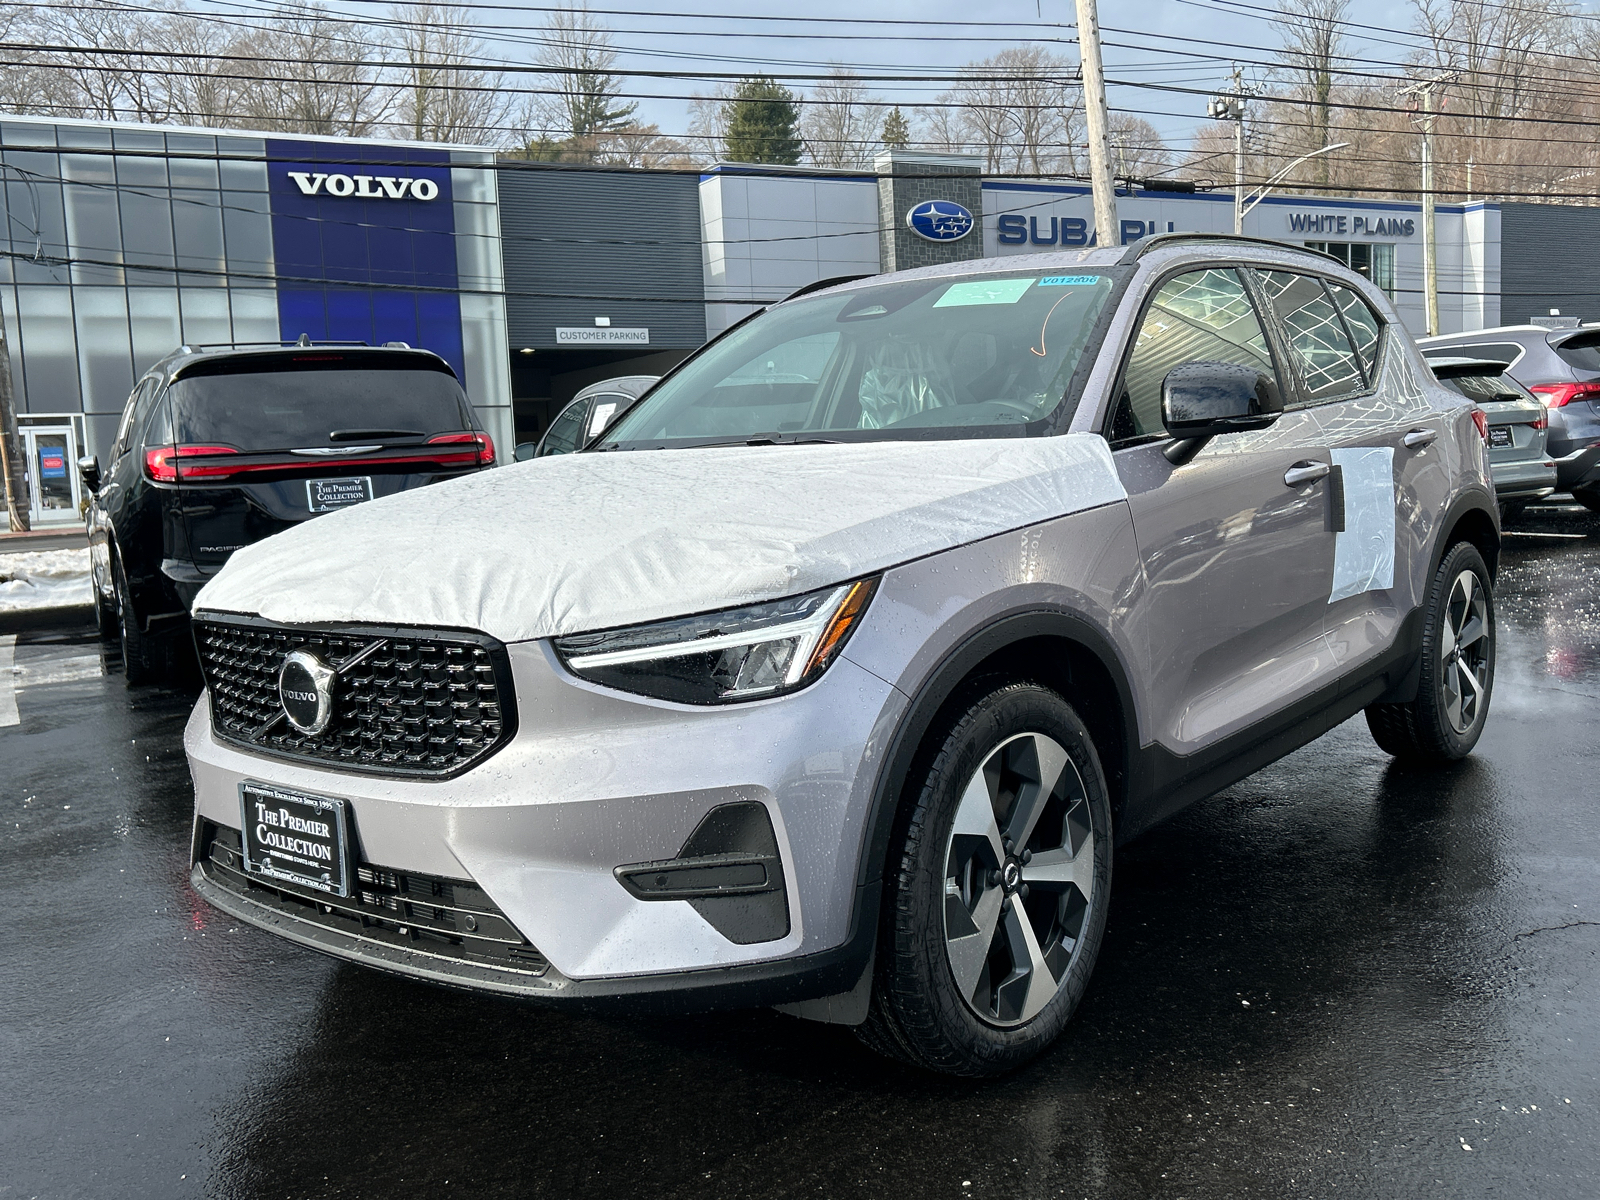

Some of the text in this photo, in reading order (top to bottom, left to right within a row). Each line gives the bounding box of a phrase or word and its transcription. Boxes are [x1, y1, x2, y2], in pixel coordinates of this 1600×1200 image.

[287, 171, 439, 200] VOLVO
[999, 214, 1174, 246] SUBR
[1289, 213, 1415, 236] WHITE PLAINS
[559, 331, 646, 340] CUSTOMER PARKING
[317, 492, 364, 501] COLLECTION
[200, 544, 247, 552] PACIFIC
[281, 689, 317, 702] VOLVO
[319, 800, 333, 810] 1995
[255, 802, 331, 838] THE PREMIER
[256, 824, 332, 861] COLLECTION
